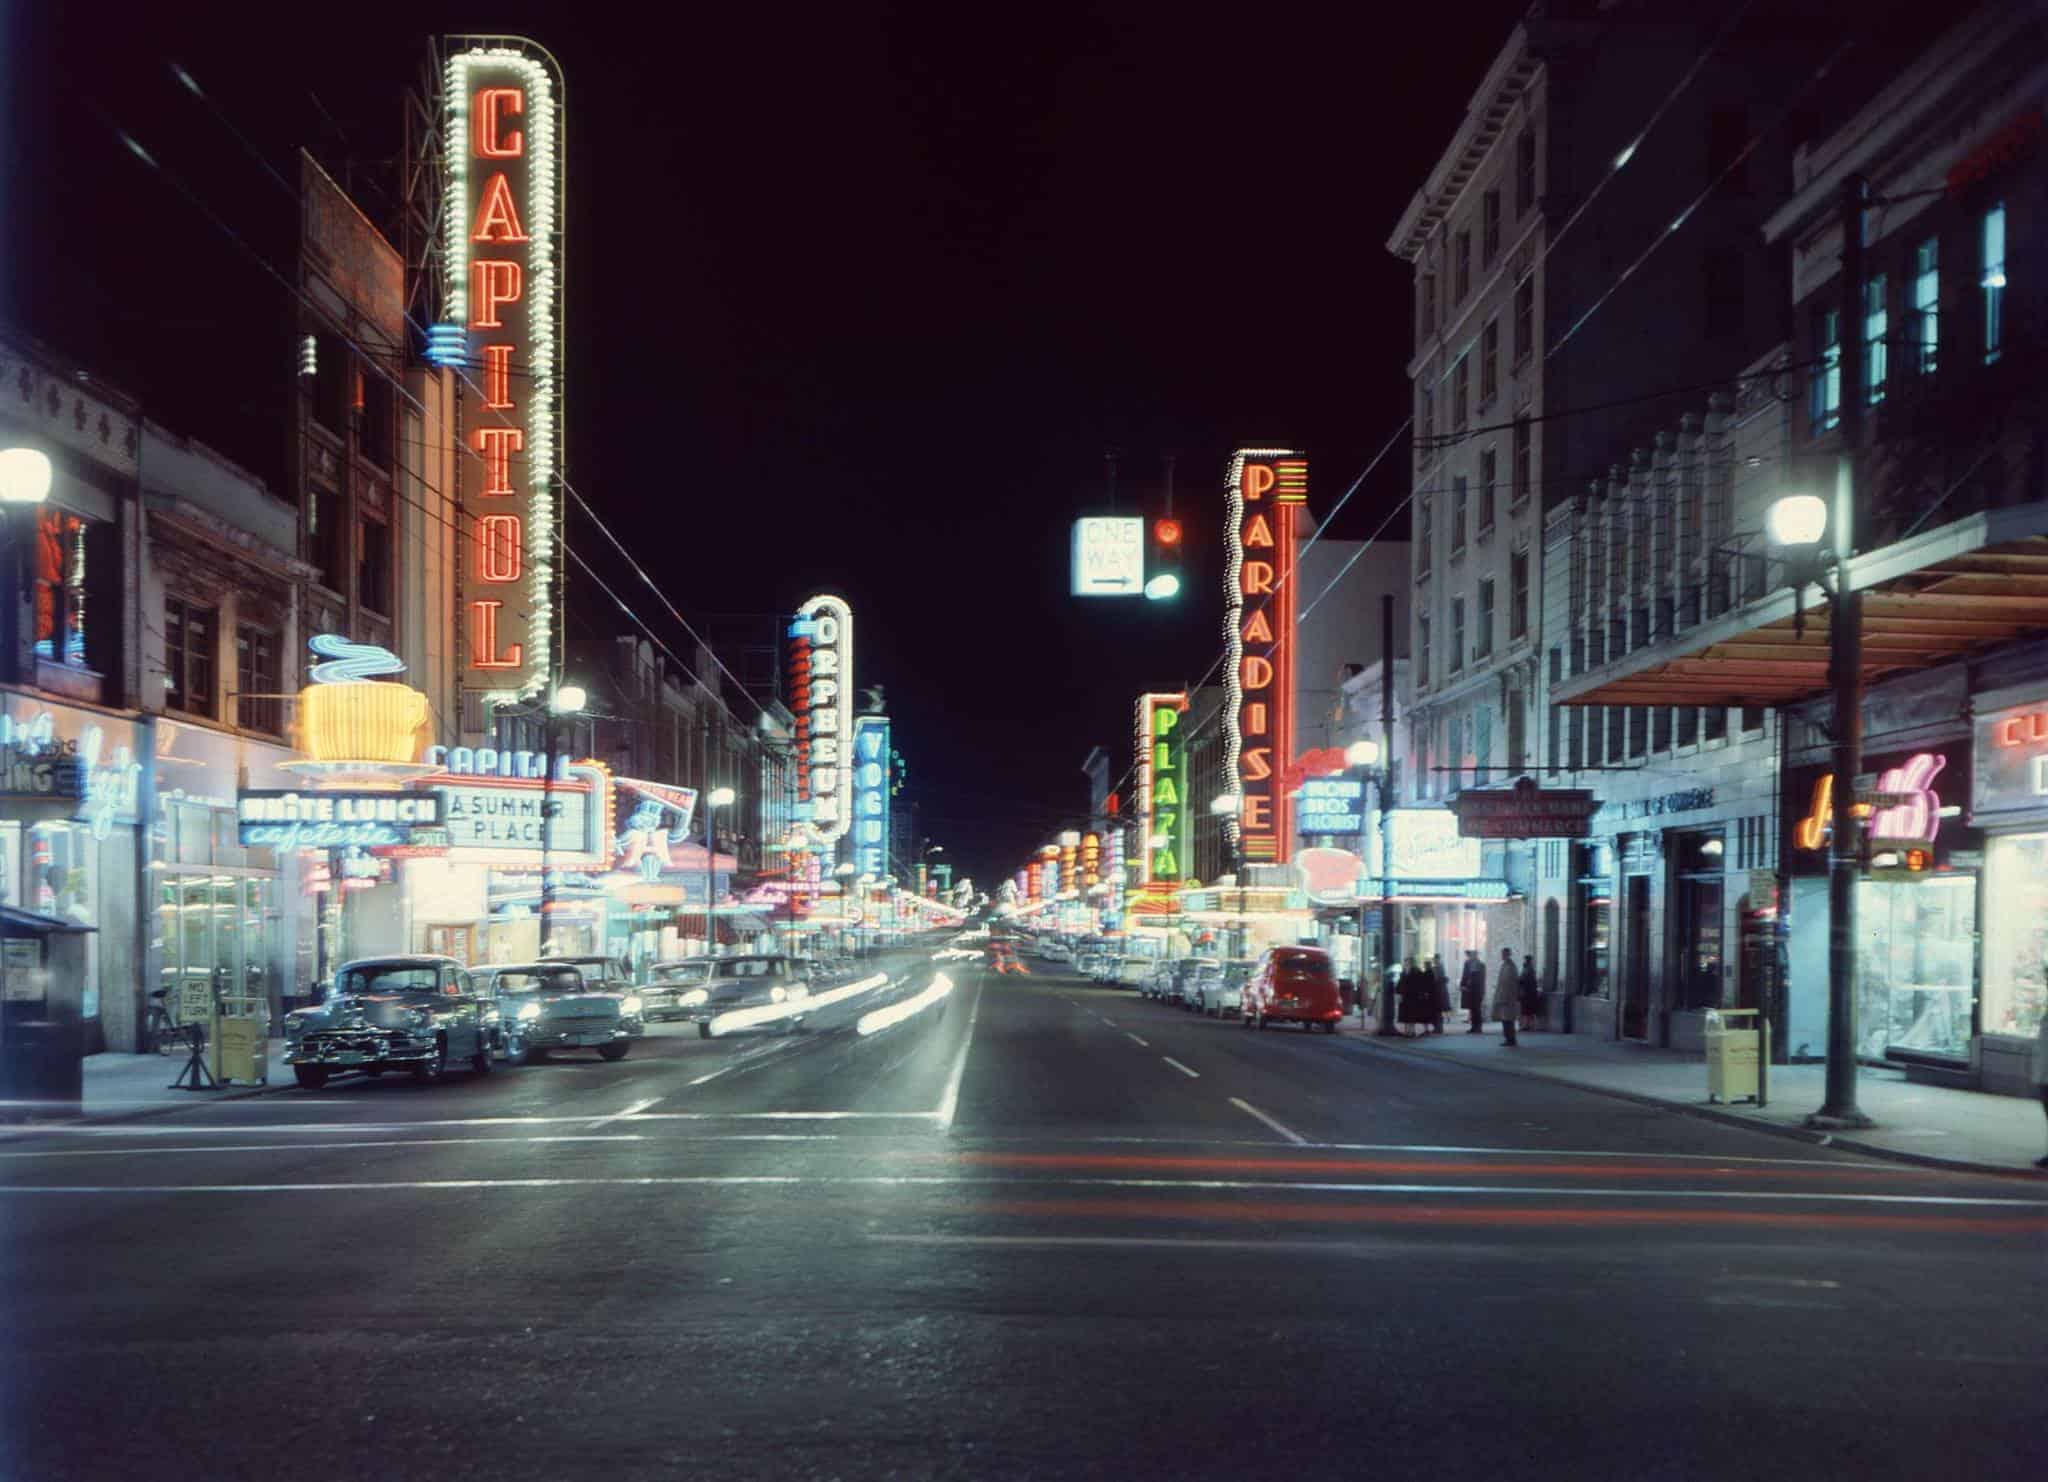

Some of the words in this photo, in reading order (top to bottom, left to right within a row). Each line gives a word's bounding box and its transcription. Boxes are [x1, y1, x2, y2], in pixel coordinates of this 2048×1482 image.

[469, 87, 529, 669] CAPITOL
[1087, 521, 1137, 543] ONE
[808, 616, 839, 821] ORPHEUM
[1242, 465, 1275, 828] PARADISE
[336, 798, 437, 822] LUNCH
[451, 795, 465, 813] A
[471, 796, 567, 818] SUMMR
[859, 732, 883, 877] VOGUE
[1153, 708, 1178, 873] PLAZA
